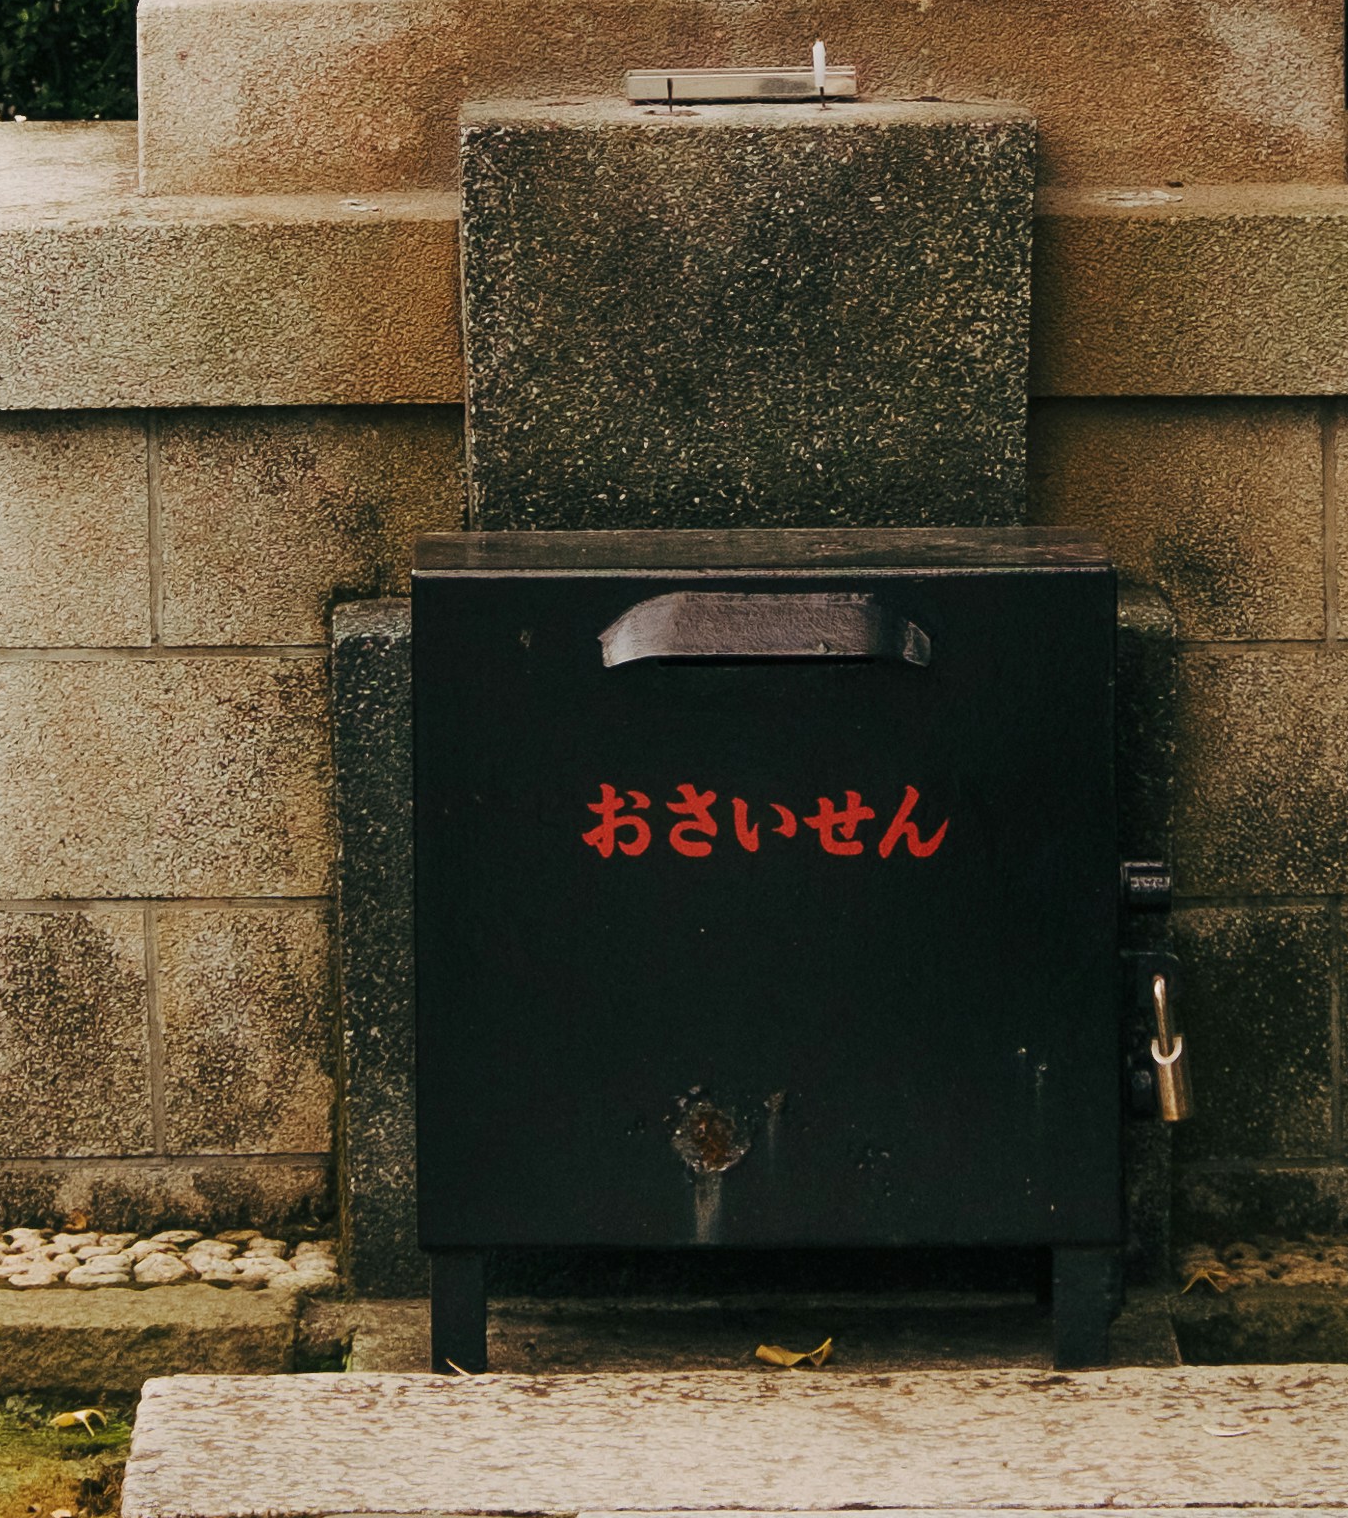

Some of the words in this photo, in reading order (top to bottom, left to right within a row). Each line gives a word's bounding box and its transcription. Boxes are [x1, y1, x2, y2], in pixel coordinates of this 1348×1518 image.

[581, 782, 950, 860] おさいせん
